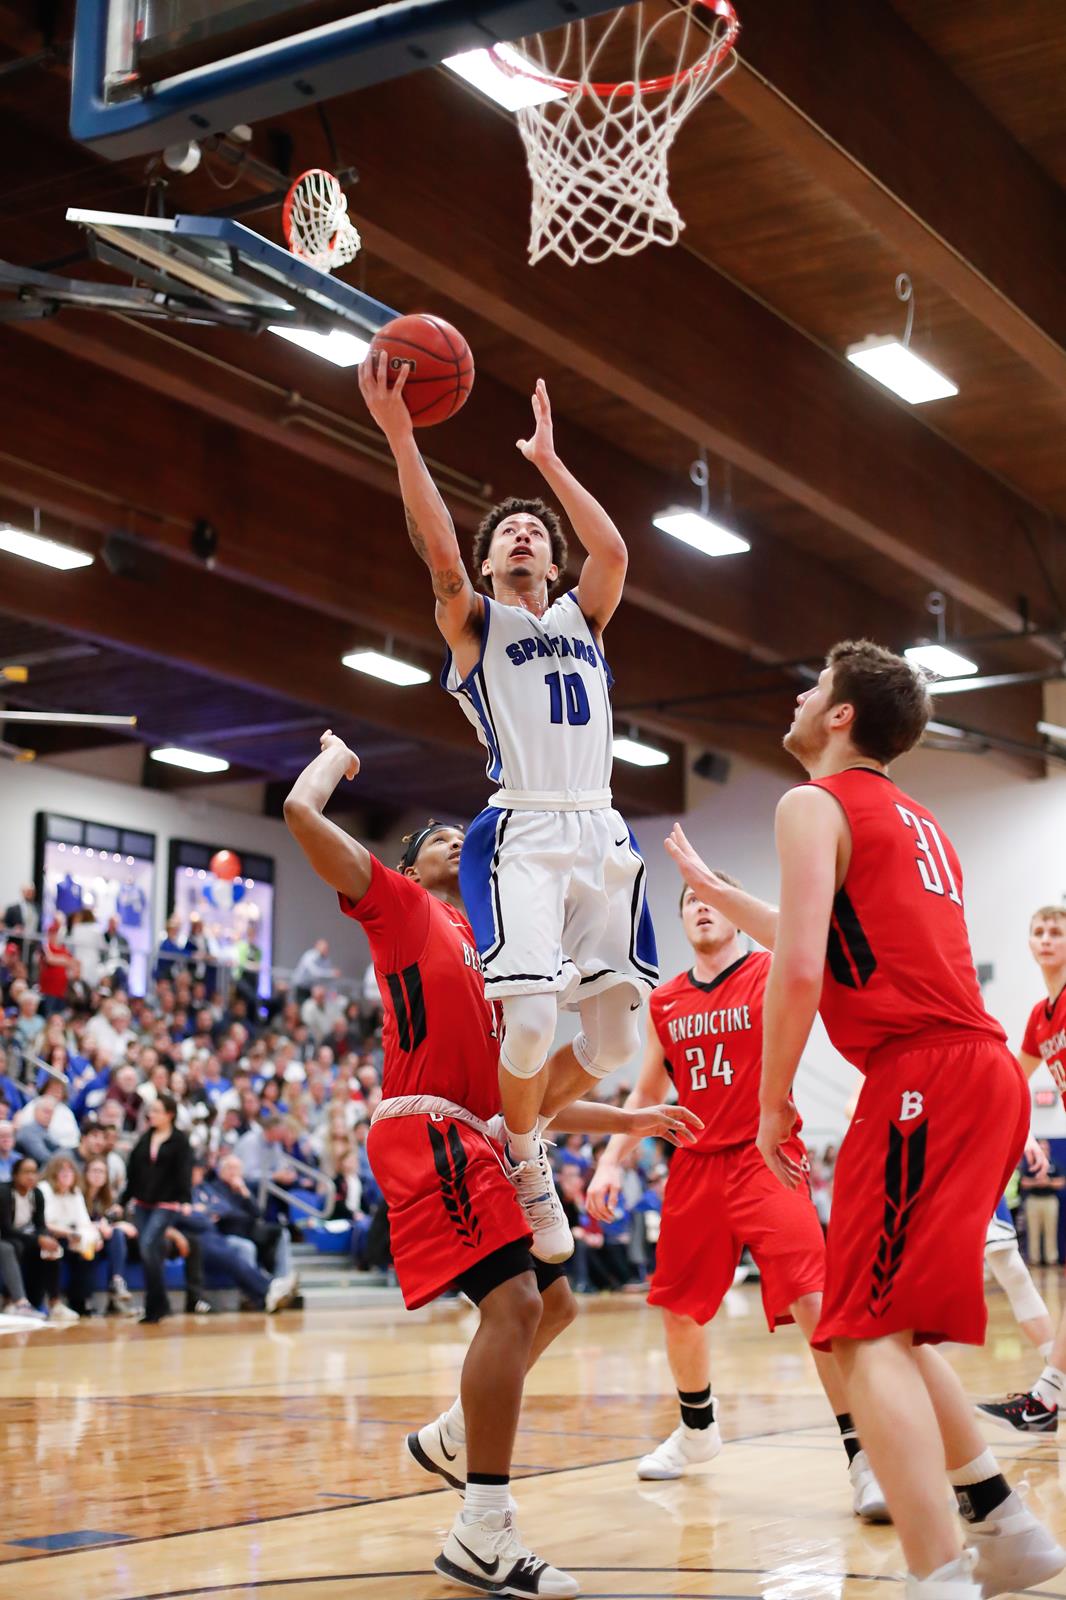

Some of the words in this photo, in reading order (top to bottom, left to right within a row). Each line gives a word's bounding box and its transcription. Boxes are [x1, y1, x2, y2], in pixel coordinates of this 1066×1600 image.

[505, 633, 597, 668] SPATANS
[544, 670, 591, 726] 10
[894, 802, 963, 907] 31
[685, 1042, 734, 1091] 24
[899, 1089, 924, 1122] B
